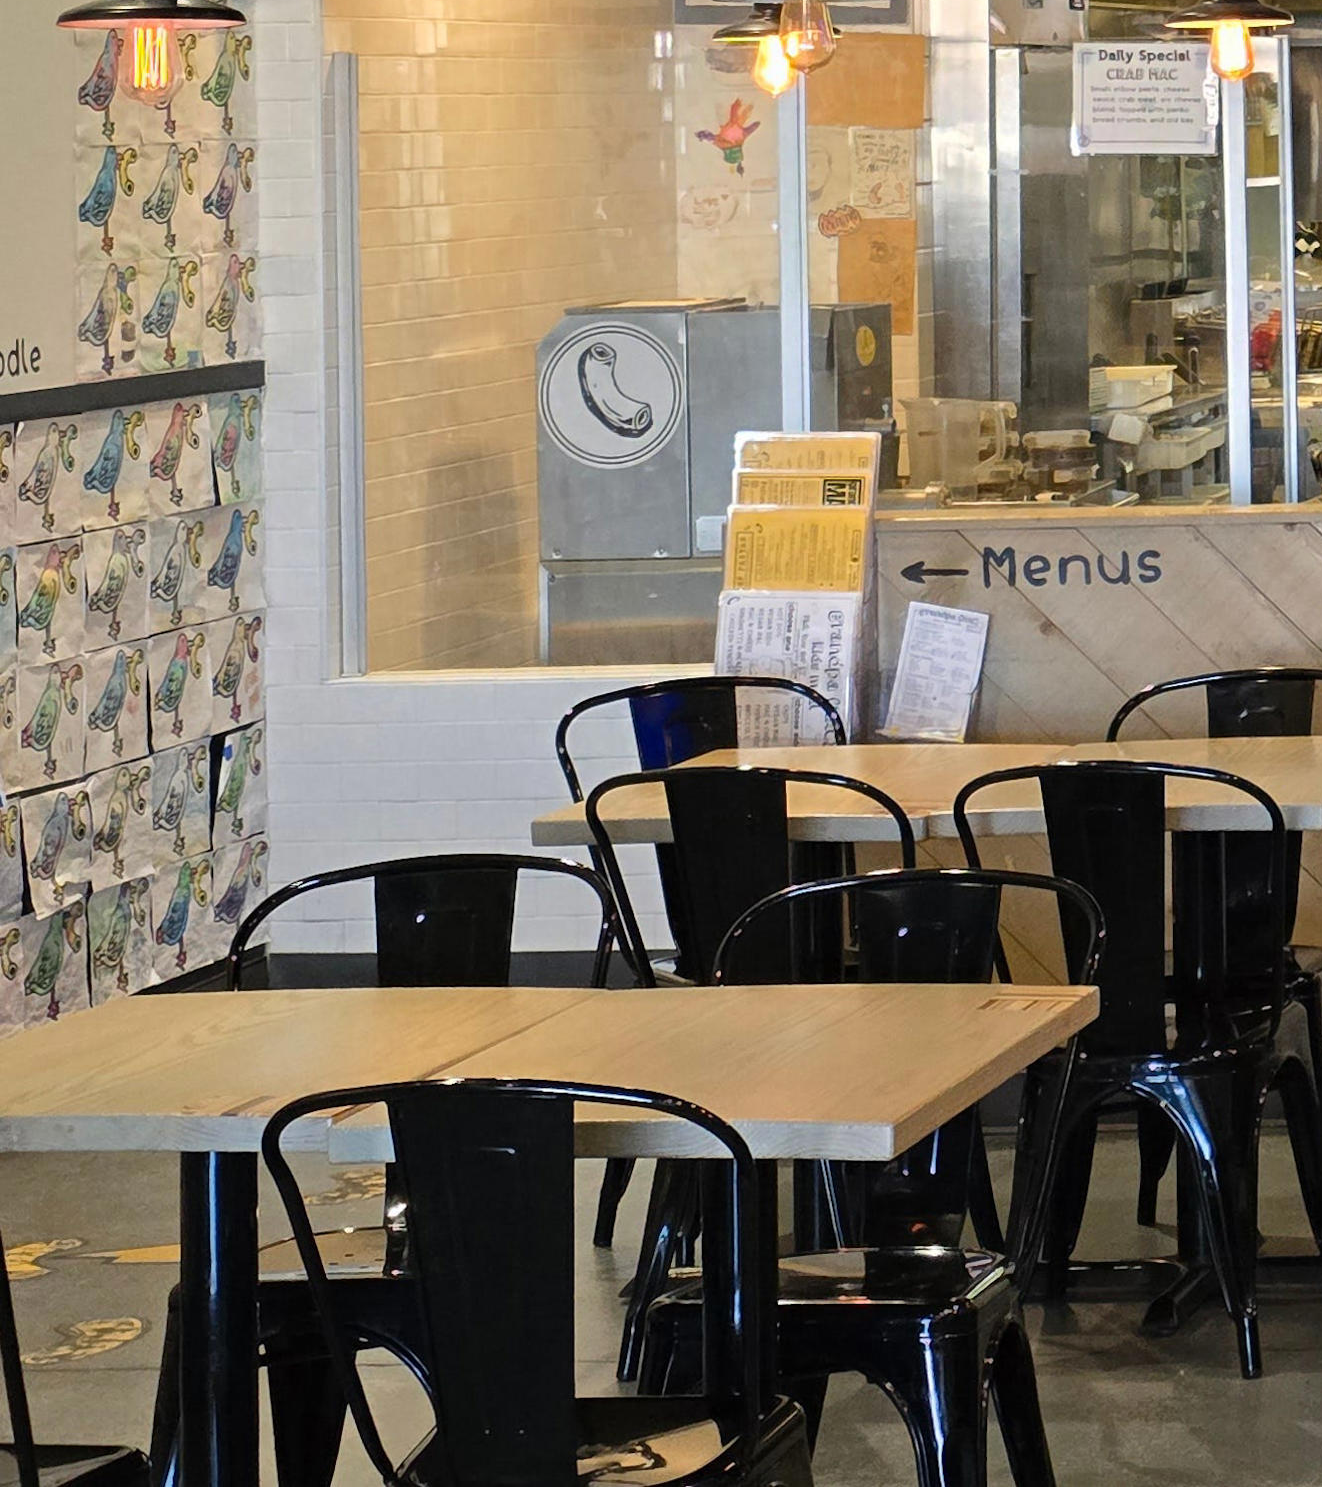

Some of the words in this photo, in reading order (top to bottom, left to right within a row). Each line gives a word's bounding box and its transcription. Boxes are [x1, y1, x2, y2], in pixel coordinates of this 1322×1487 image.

[1098, 49, 1134, 64] Daily
[1139, 49, 1192, 64] Special
[1106, 68, 1145, 81] CRAB
[1148, 68, 1179, 81] MAC
[982, 546, 1165, 589] Menus
